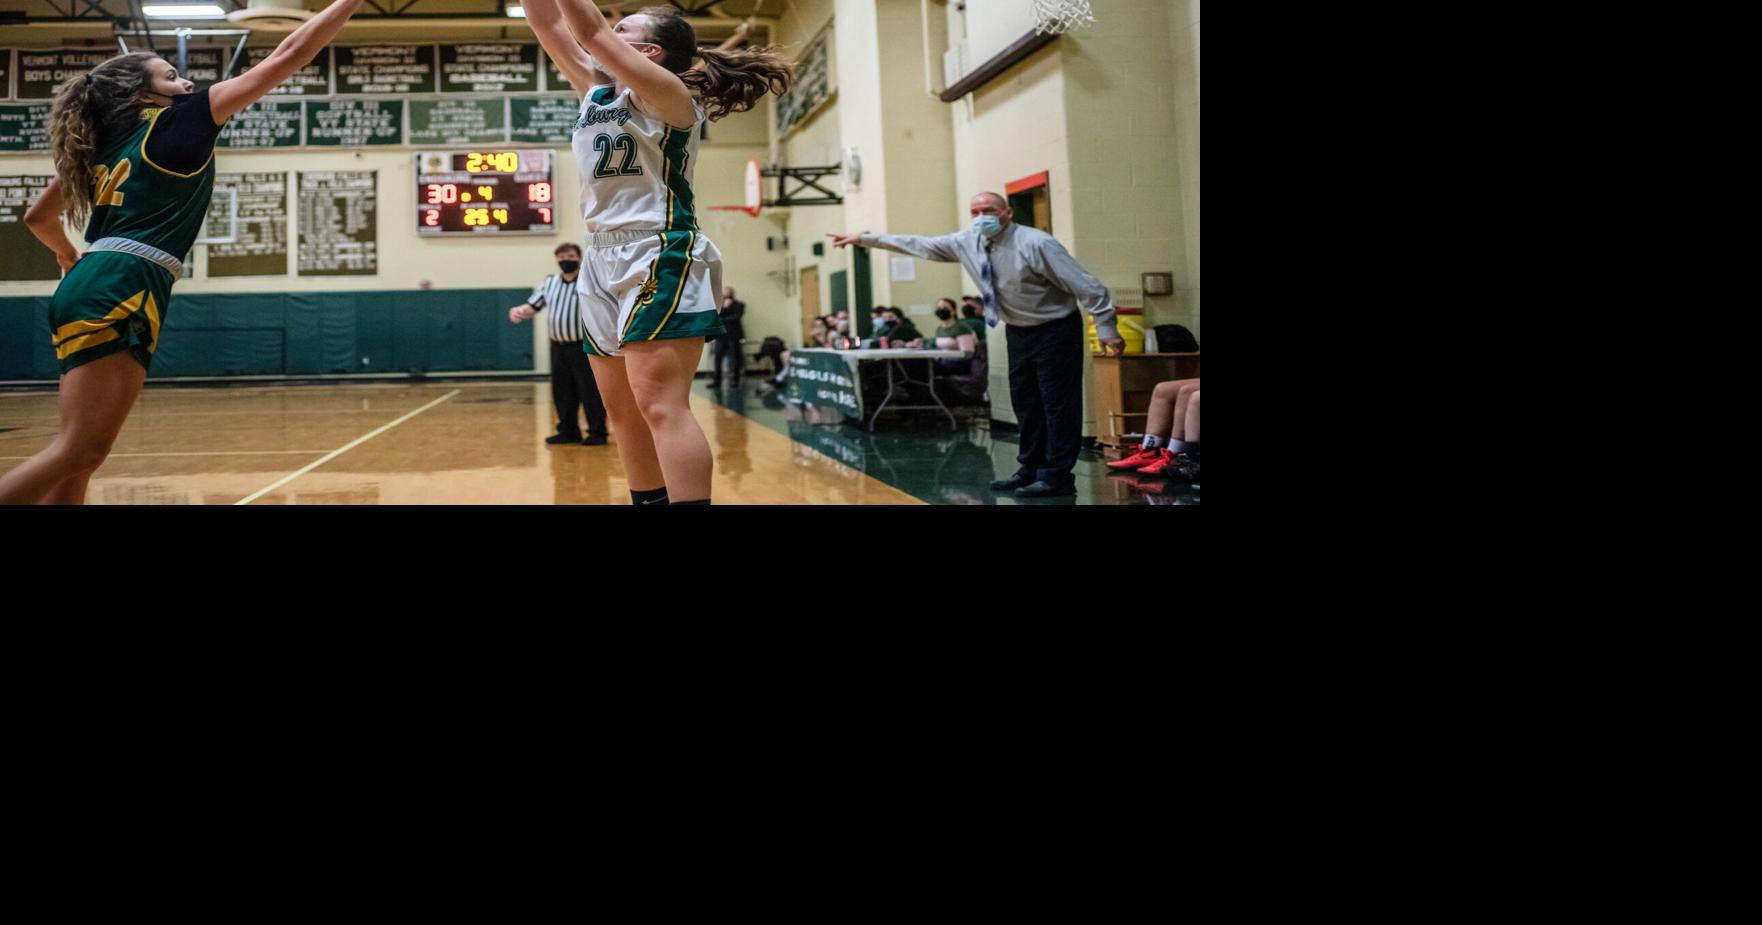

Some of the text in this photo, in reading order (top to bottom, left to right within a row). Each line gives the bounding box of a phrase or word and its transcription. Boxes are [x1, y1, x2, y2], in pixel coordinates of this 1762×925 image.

[24, 70, 51, 81] BOYS
[219, 129, 296, 139] UNNER-UP
[466, 153, 518, 172] 2:40
[593, 133, 643, 179] 22
[428, 182, 551, 203] 30 4 18
[426, 208, 551, 225] 2 25 4 7
